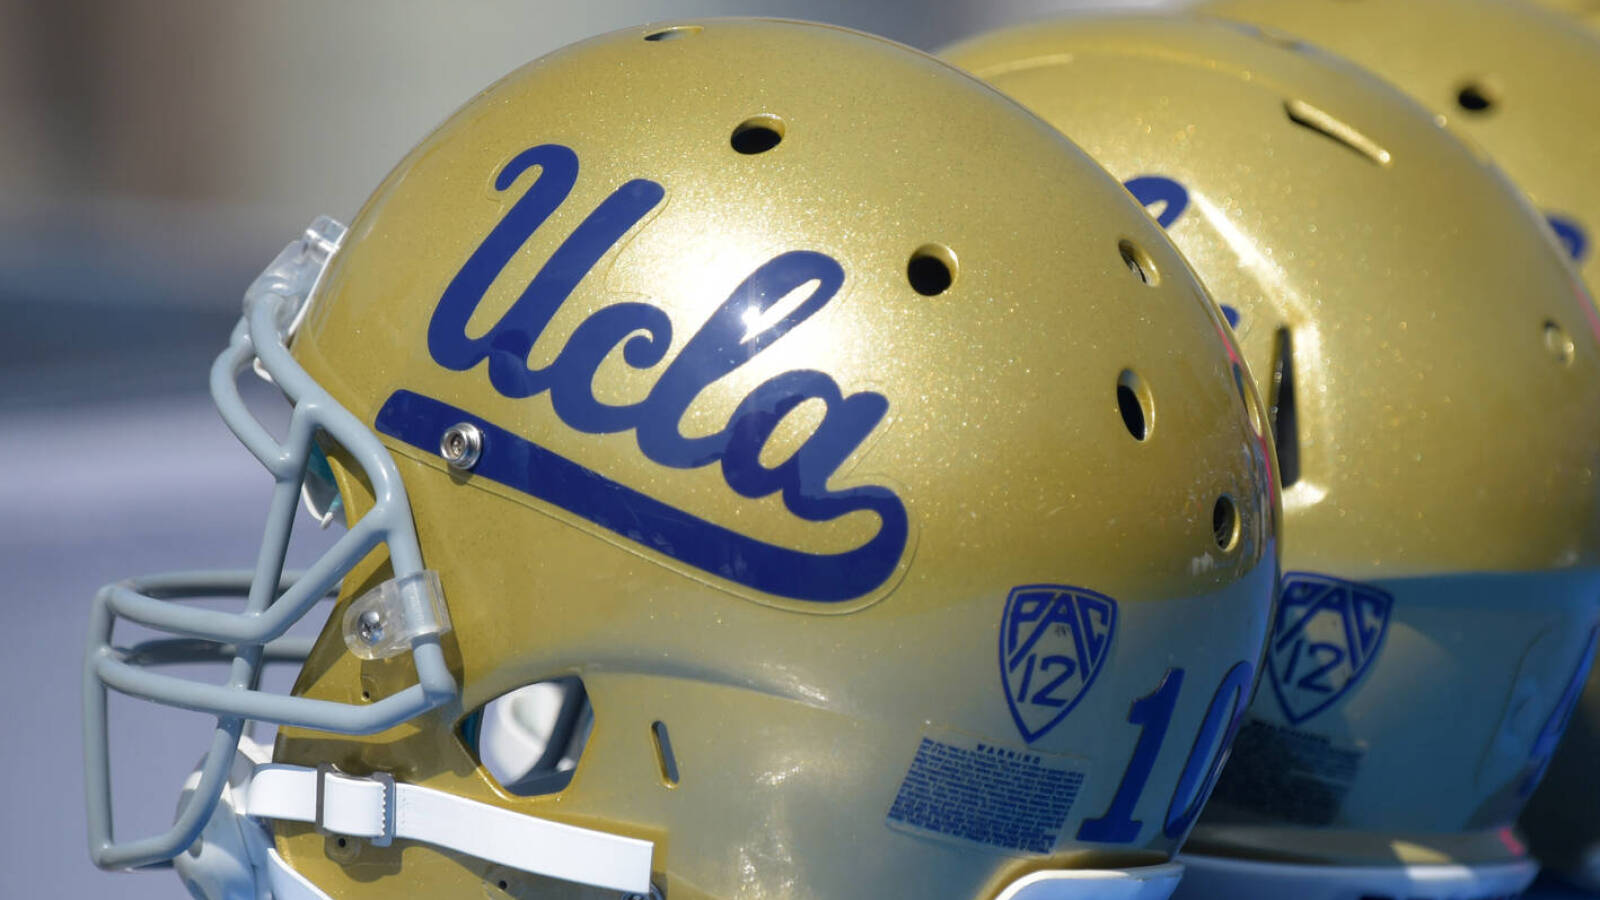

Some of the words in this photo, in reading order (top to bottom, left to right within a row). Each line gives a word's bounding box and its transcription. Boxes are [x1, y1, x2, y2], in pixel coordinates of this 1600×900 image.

[1008, 592, 1110, 683] PAC
[1276, 580, 1385, 671] PAC
[1017, 653, 1076, 708] 12
[1283, 638, 1345, 693] 12
[976, 743, 1041, 765] WARNING
[1076, 660, 1253, 844] 10
